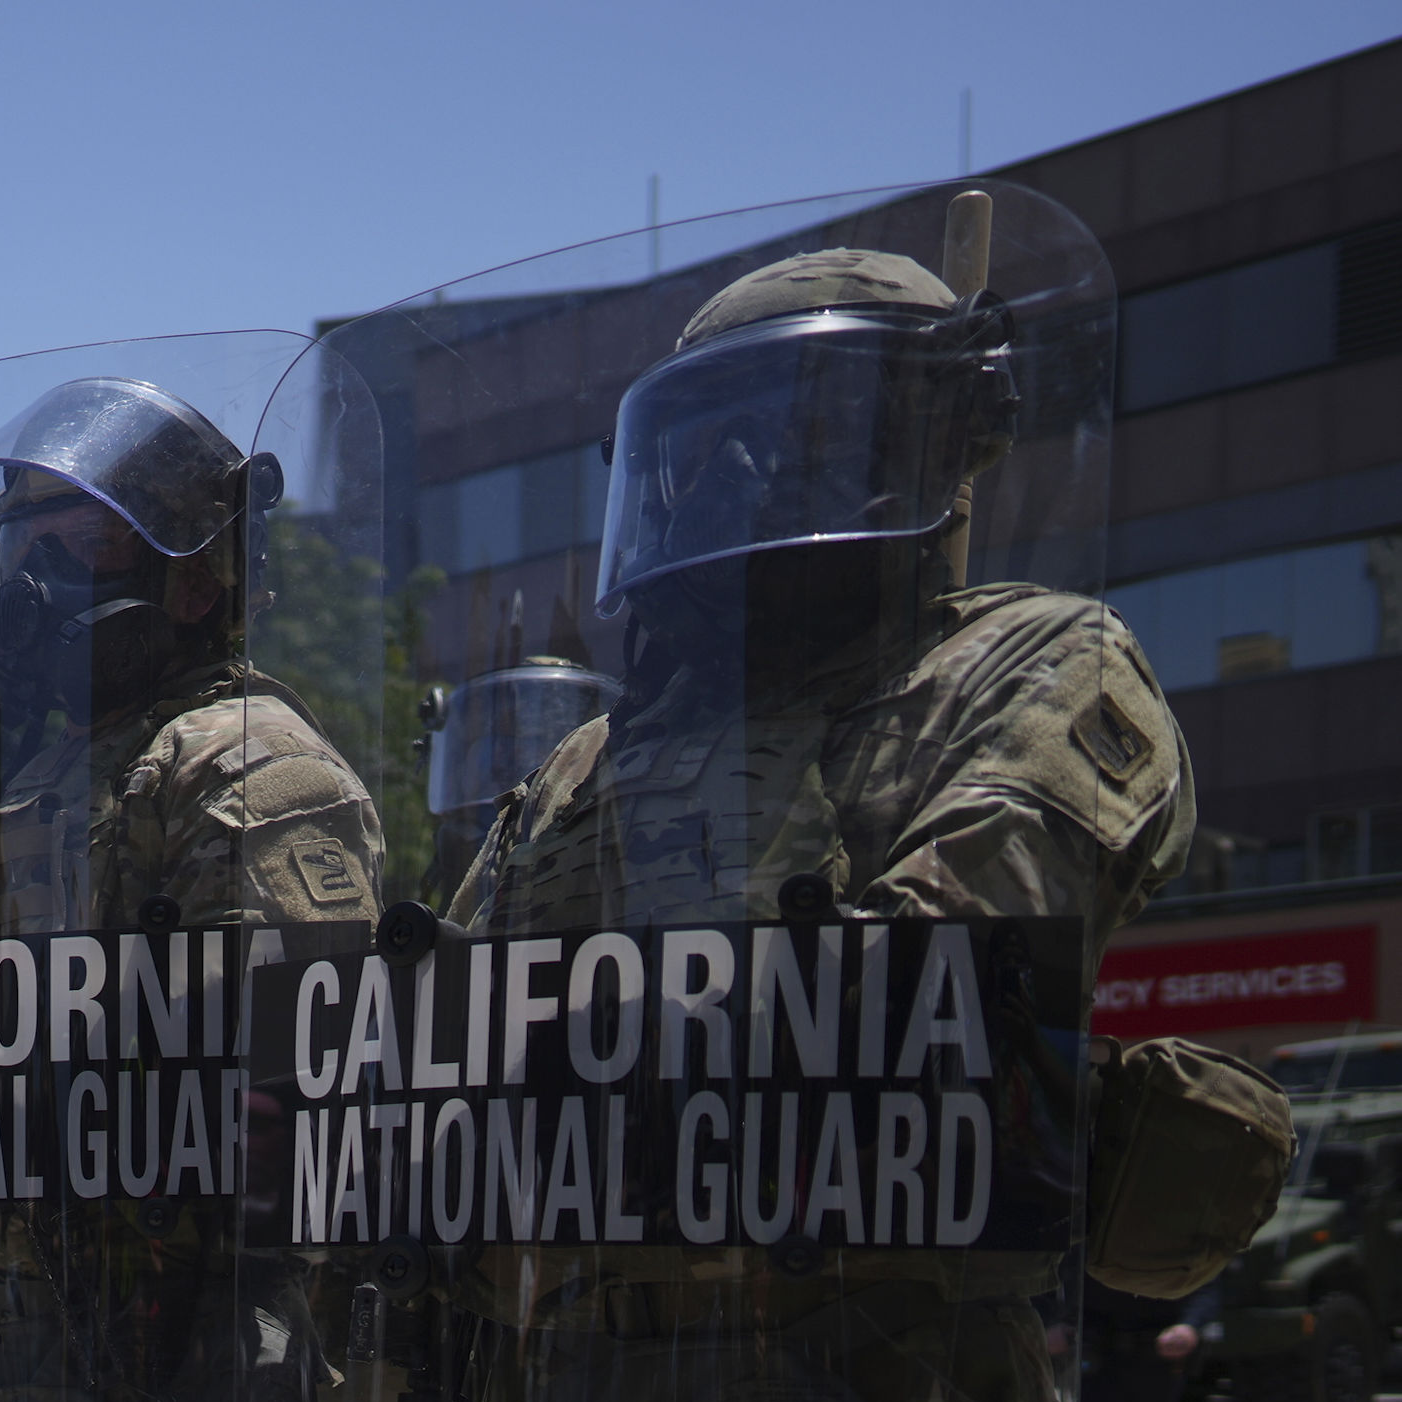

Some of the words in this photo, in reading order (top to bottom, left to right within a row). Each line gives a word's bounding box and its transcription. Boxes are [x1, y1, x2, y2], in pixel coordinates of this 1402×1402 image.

[294, 923, 993, 1100] CALIFORNIA
[1093, 977, 1157, 1010] NCY
[1160, 961, 1347, 1006] SERVICES
[68, 1069, 250, 1198] GUAR
[291, 1094, 645, 1247] NATIONAL
[676, 1090, 994, 1247] GUARD
